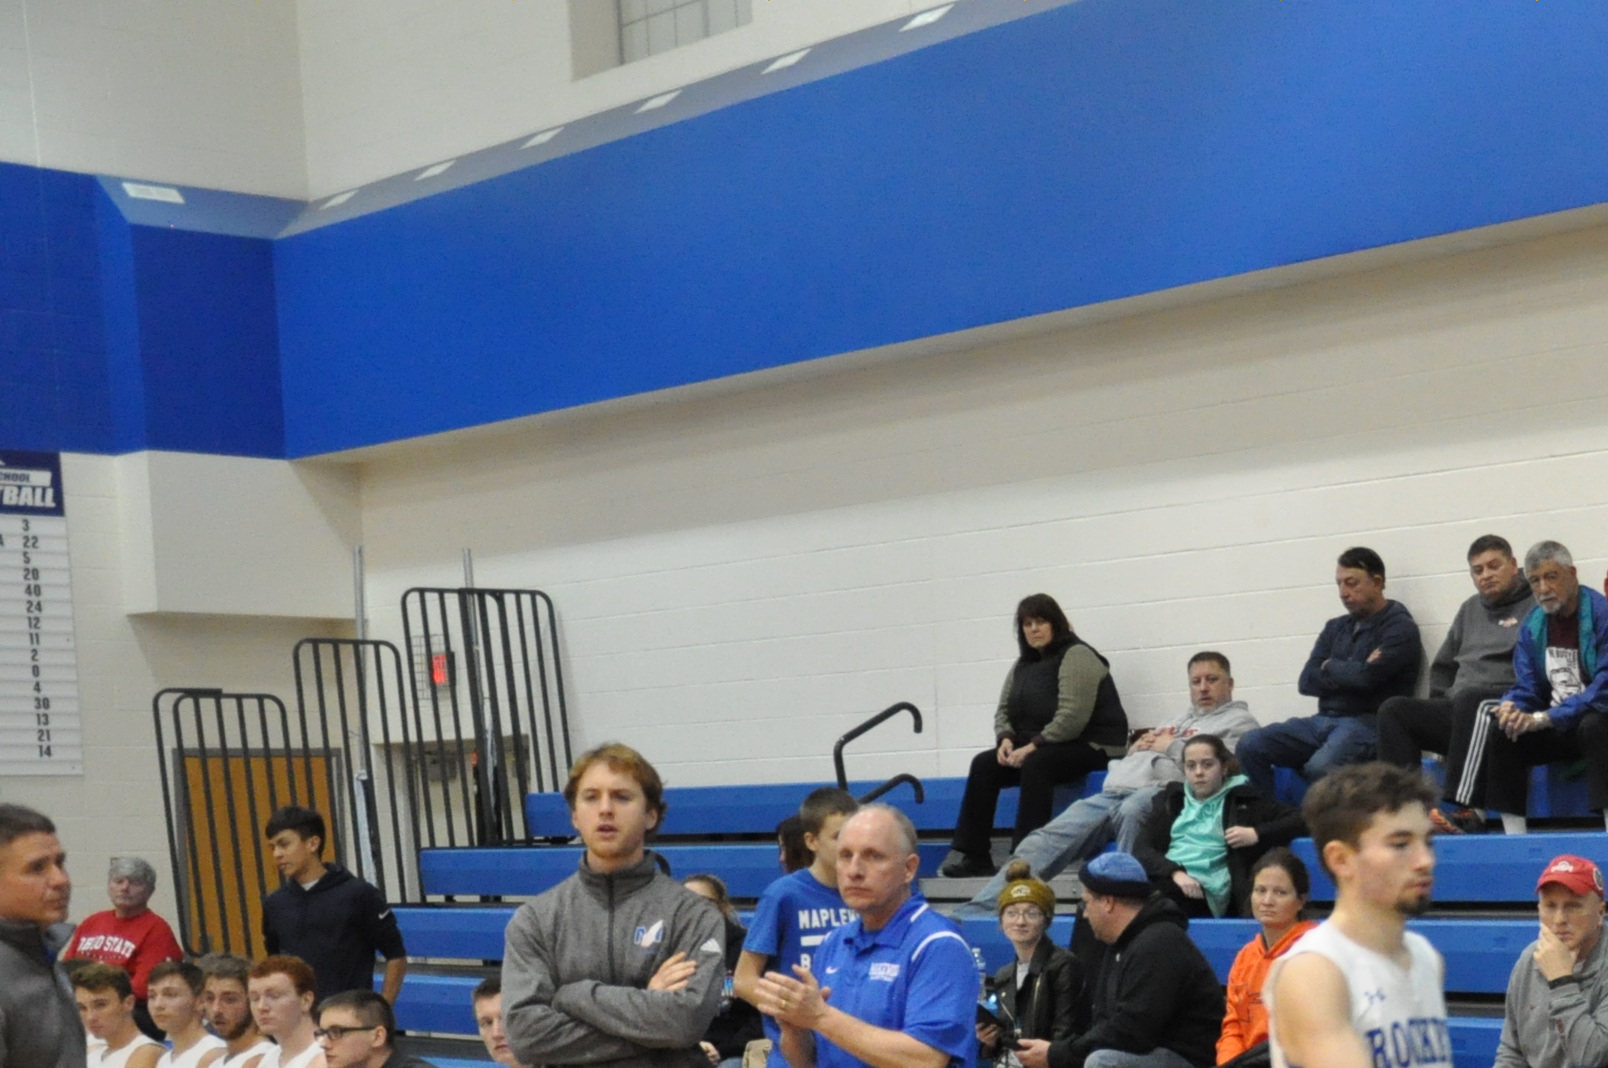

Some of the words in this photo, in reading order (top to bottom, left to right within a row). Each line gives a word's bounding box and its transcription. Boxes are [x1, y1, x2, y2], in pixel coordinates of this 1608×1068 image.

[0, 485, 56, 508] BALL
[22, 519, 30, 532] 3
[23, 536, 39, 549] 22
[23, 568, 40, 581] 20
[25, 584, 42, 597] 40
[26, 601, 42, 614] 24
[27, 616, 41, 630] 12
[29, 632, 40, 646] 11
[31, 648, 39, 662] 2
[32, 664, 40, 678] 0
[33, 681, 41, 694] 4
[36, 713, 49, 726] 13
[37, 729, 51, 742] 21
[39, 745, 52, 758] 14
[798, 908, 860, 930] MAPLEW
